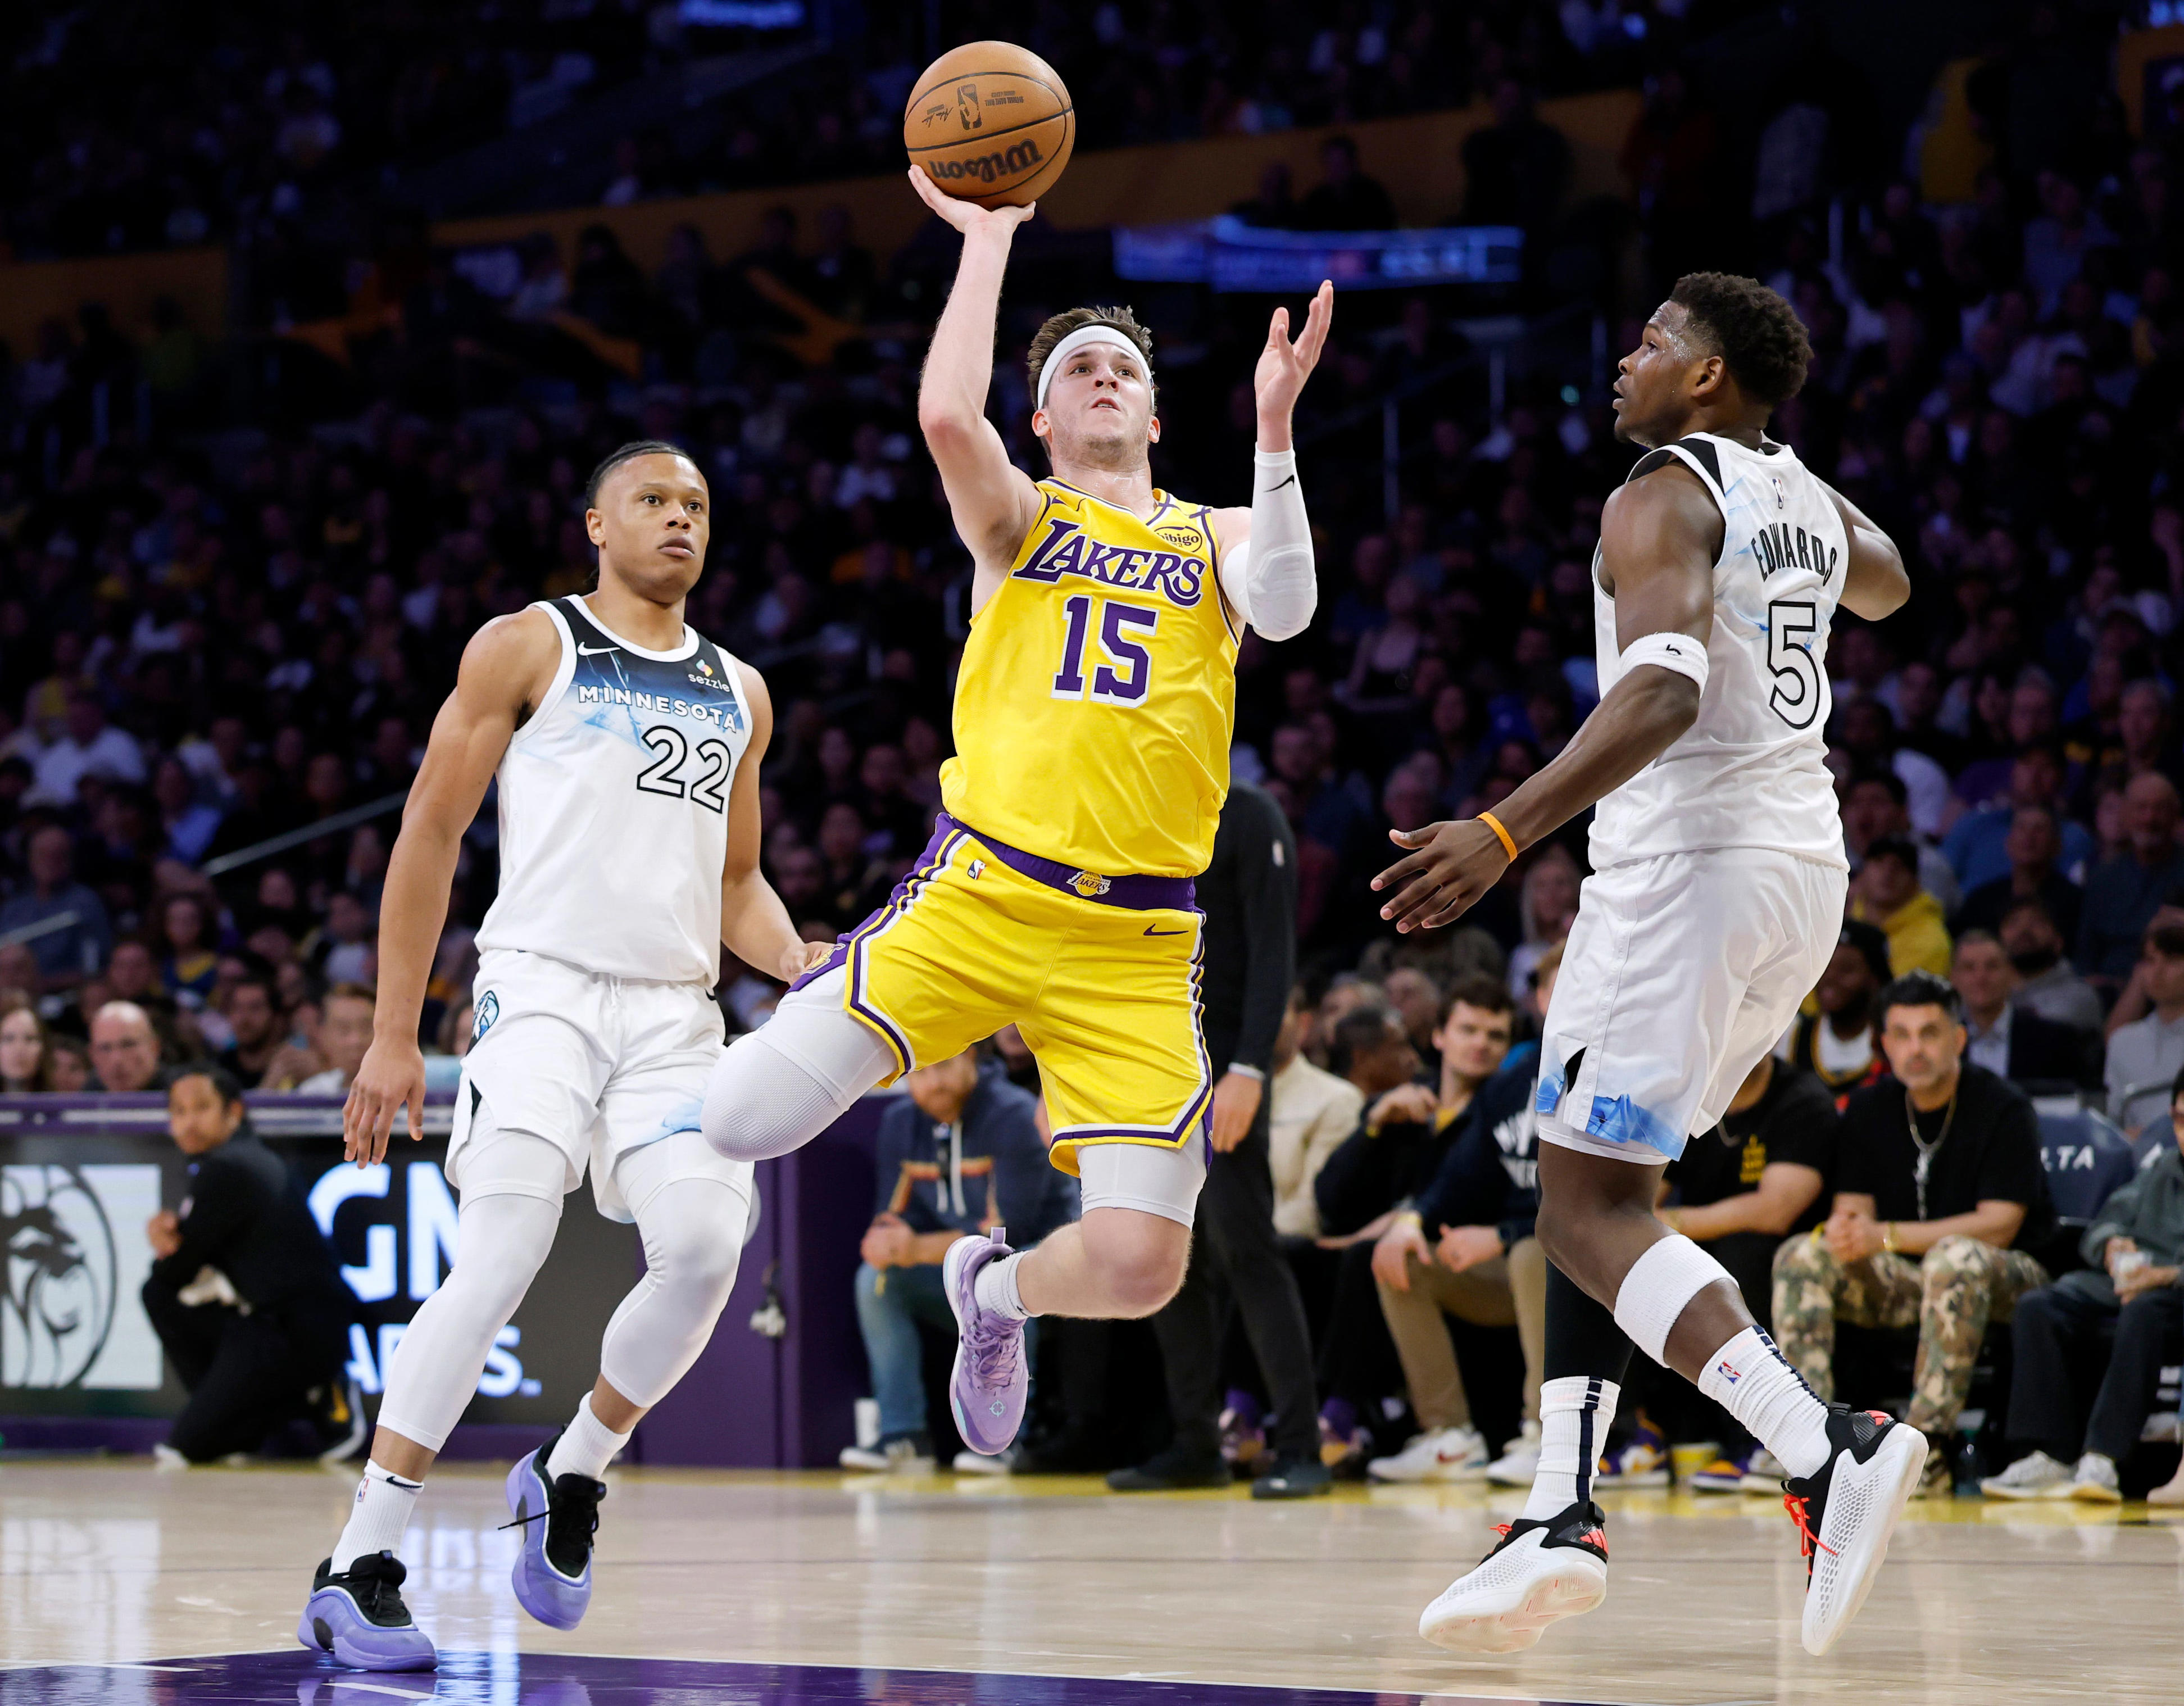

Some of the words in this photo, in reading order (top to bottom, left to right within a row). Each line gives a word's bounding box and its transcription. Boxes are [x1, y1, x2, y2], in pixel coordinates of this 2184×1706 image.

[928, 138, 1043, 183] Wilson
[1010, 516, 1207, 609] LAKERS
[1751, 523, 1837, 587] EDWARDS
[687, 673, 730, 692] sezzle
[1050, 594, 1160, 709] 15
[1768, 600, 1820, 729] 5
[578, 685, 737, 734] MINNESOTA
[637, 725, 731, 814] 22
[1070, 873, 1109, 894] LAKERS
